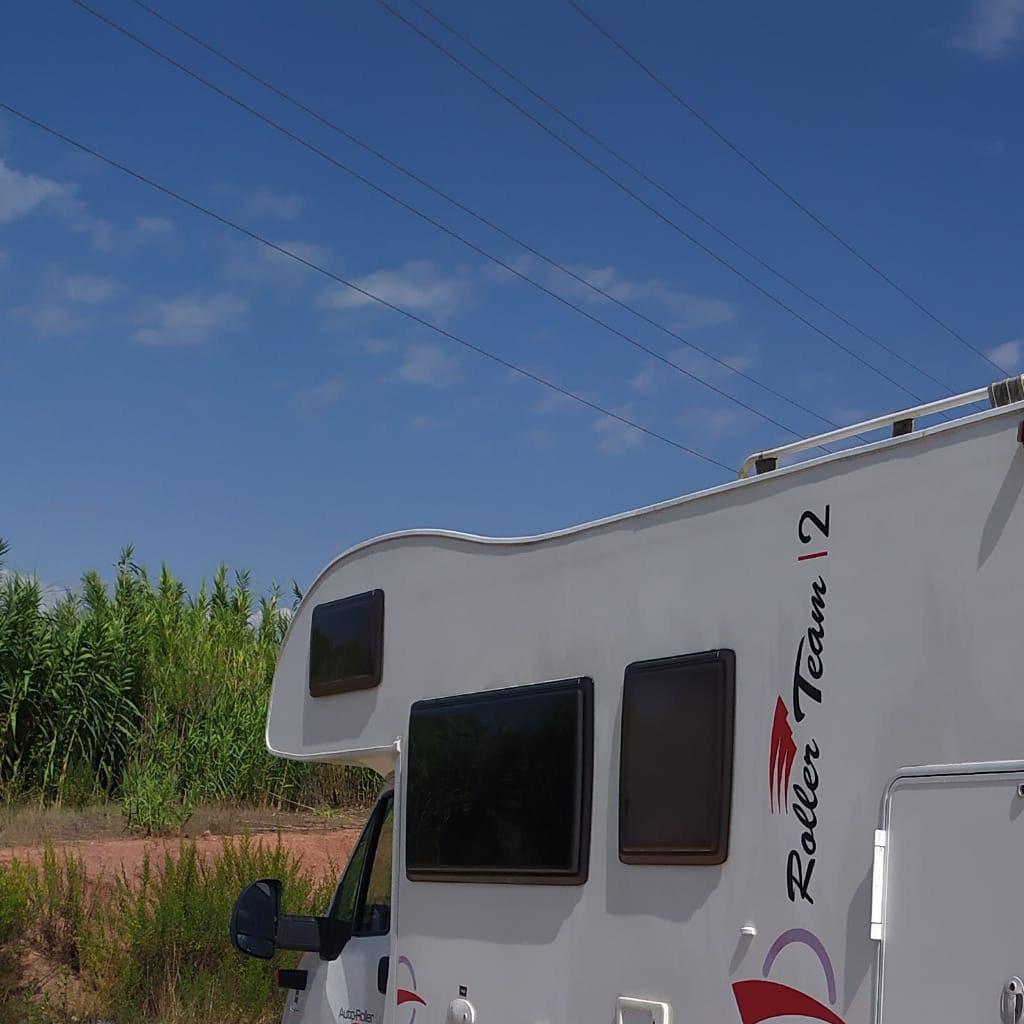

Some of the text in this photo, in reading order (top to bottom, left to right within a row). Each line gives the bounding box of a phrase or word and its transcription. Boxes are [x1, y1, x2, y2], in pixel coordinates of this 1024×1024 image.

[787, 504, 831, 905] Roller Team 2
